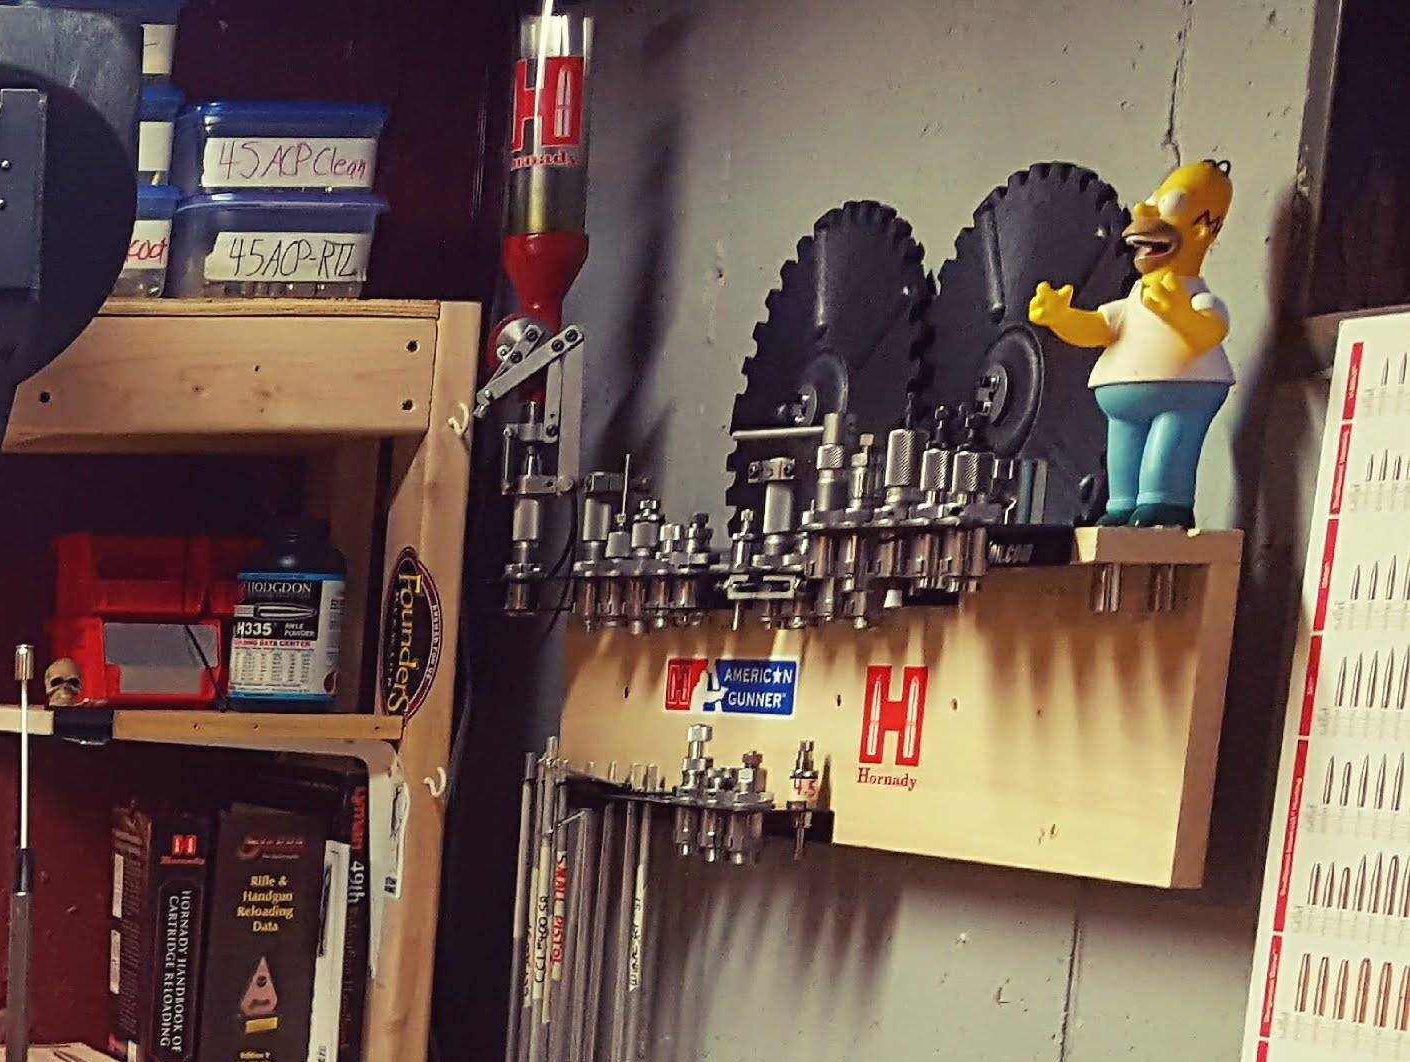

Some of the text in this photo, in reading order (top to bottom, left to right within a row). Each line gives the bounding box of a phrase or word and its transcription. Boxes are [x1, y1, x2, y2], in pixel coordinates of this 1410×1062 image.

[313, 144, 368, 178] Clean
[247, 582, 312, 593] HODGDON
[236, 622, 272, 637] H335
[728, 689, 786, 709] GUNNER
[857, 767, 917, 791] Hornady
[250, 875, 287, 887] Rifle &
[346, 861, 366, 904] 49th
[243, 890, 294, 904] Handgun
[177, 890, 193, 954] HORNADY
[237, 906, 294, 919] Reloading
[252, 920, 279, 932] Data
[159, 895, 179, 1048] CARTRIDGE RELOADING
[172, 958, 188, 1031] HANDBOOK
